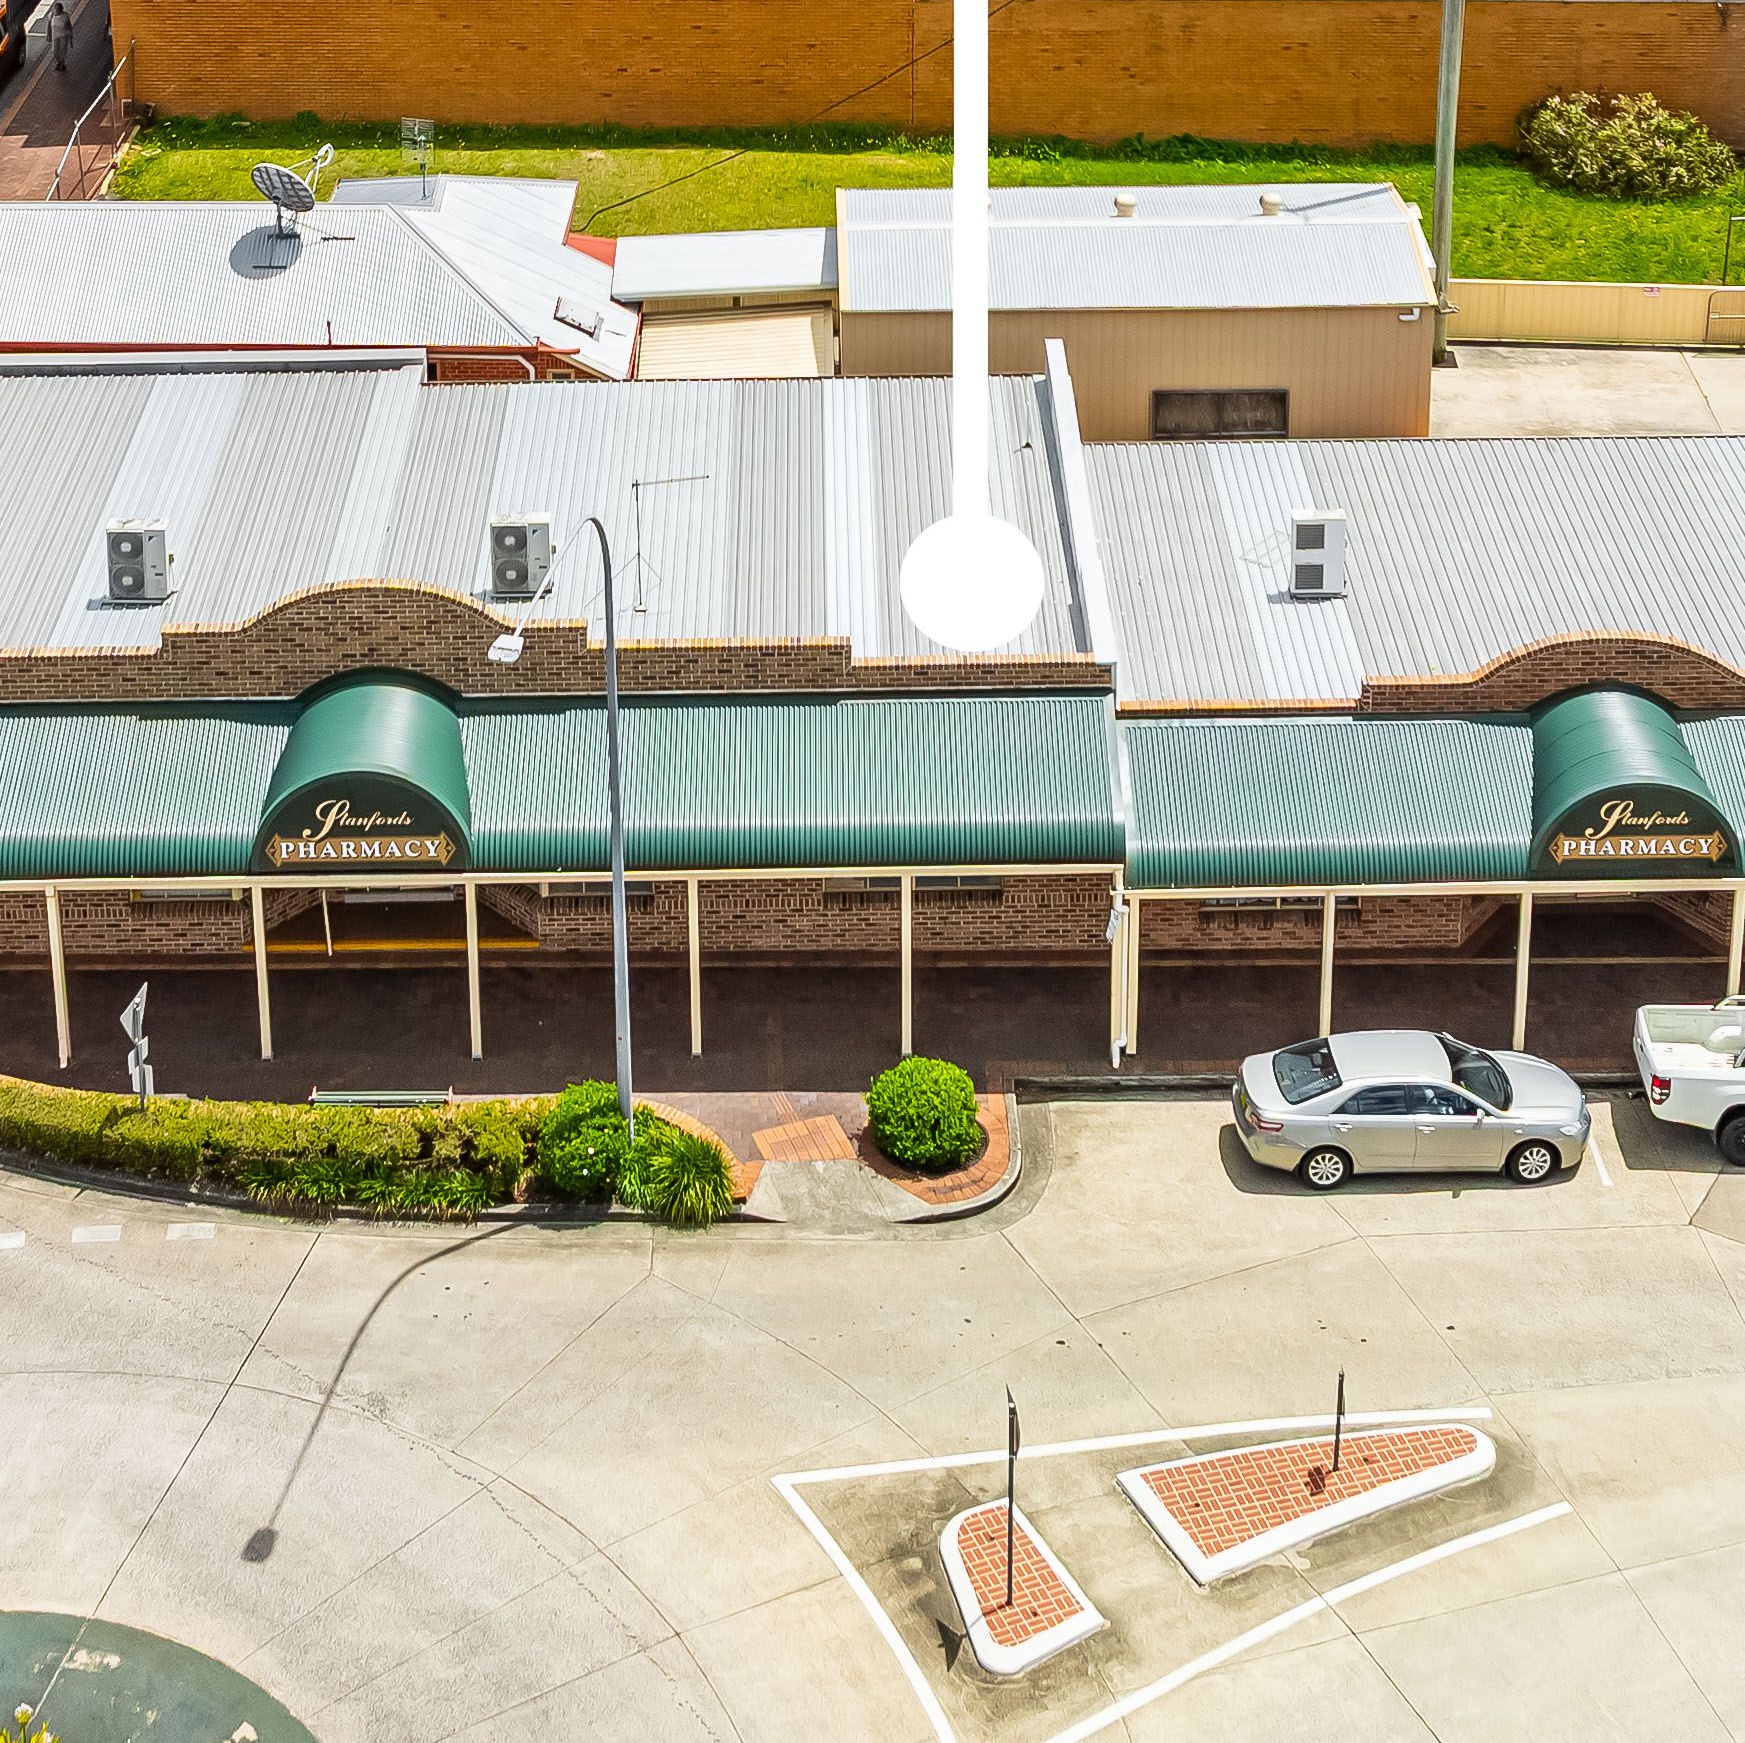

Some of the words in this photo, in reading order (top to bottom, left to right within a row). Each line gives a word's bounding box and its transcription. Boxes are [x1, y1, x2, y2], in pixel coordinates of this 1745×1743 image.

[302, 799, 415, 841] Stanfords
[1585, 800, 1693, 840] Stanfords
[280, 839, 440, 859] PHARMACY
[1562, 838, 1714, 856] PHARMACY
